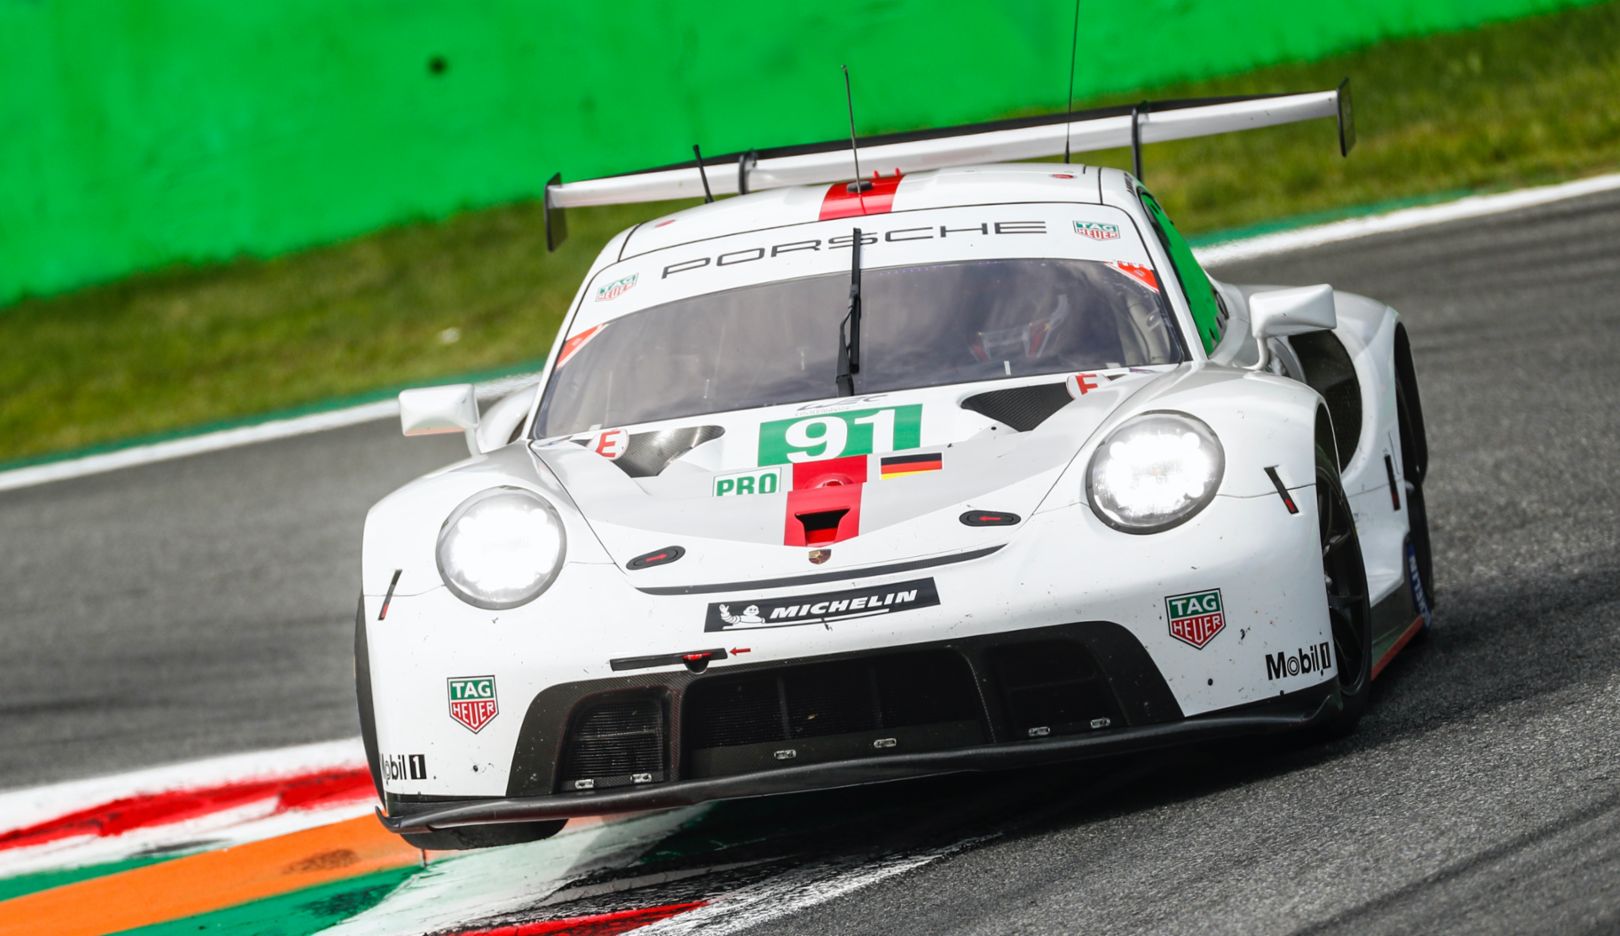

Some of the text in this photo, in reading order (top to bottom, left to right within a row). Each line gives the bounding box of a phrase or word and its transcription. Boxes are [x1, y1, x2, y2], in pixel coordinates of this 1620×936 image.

[1076, 222, 1117, 232] TAG
[1076, 229, 1118, 239] HEUER
[661, 221, 1047, 280] PORSCHE
[595, 430, 621, 457] E
[785, 408, 896, 464] 91
[716, 472, 778, 497] PRO
[769, 589, 918, 620] MICHELIN
[1171, 595, 1218, 616] TAG
[1172, 616, 1222, 644] HEUER
[1265, 644, 1319, 681] Mobil
[451, 681, 492, 698] TAG
[452, 701, 495, 727] HEUER
[381, 753, 424, 780] obil 1
